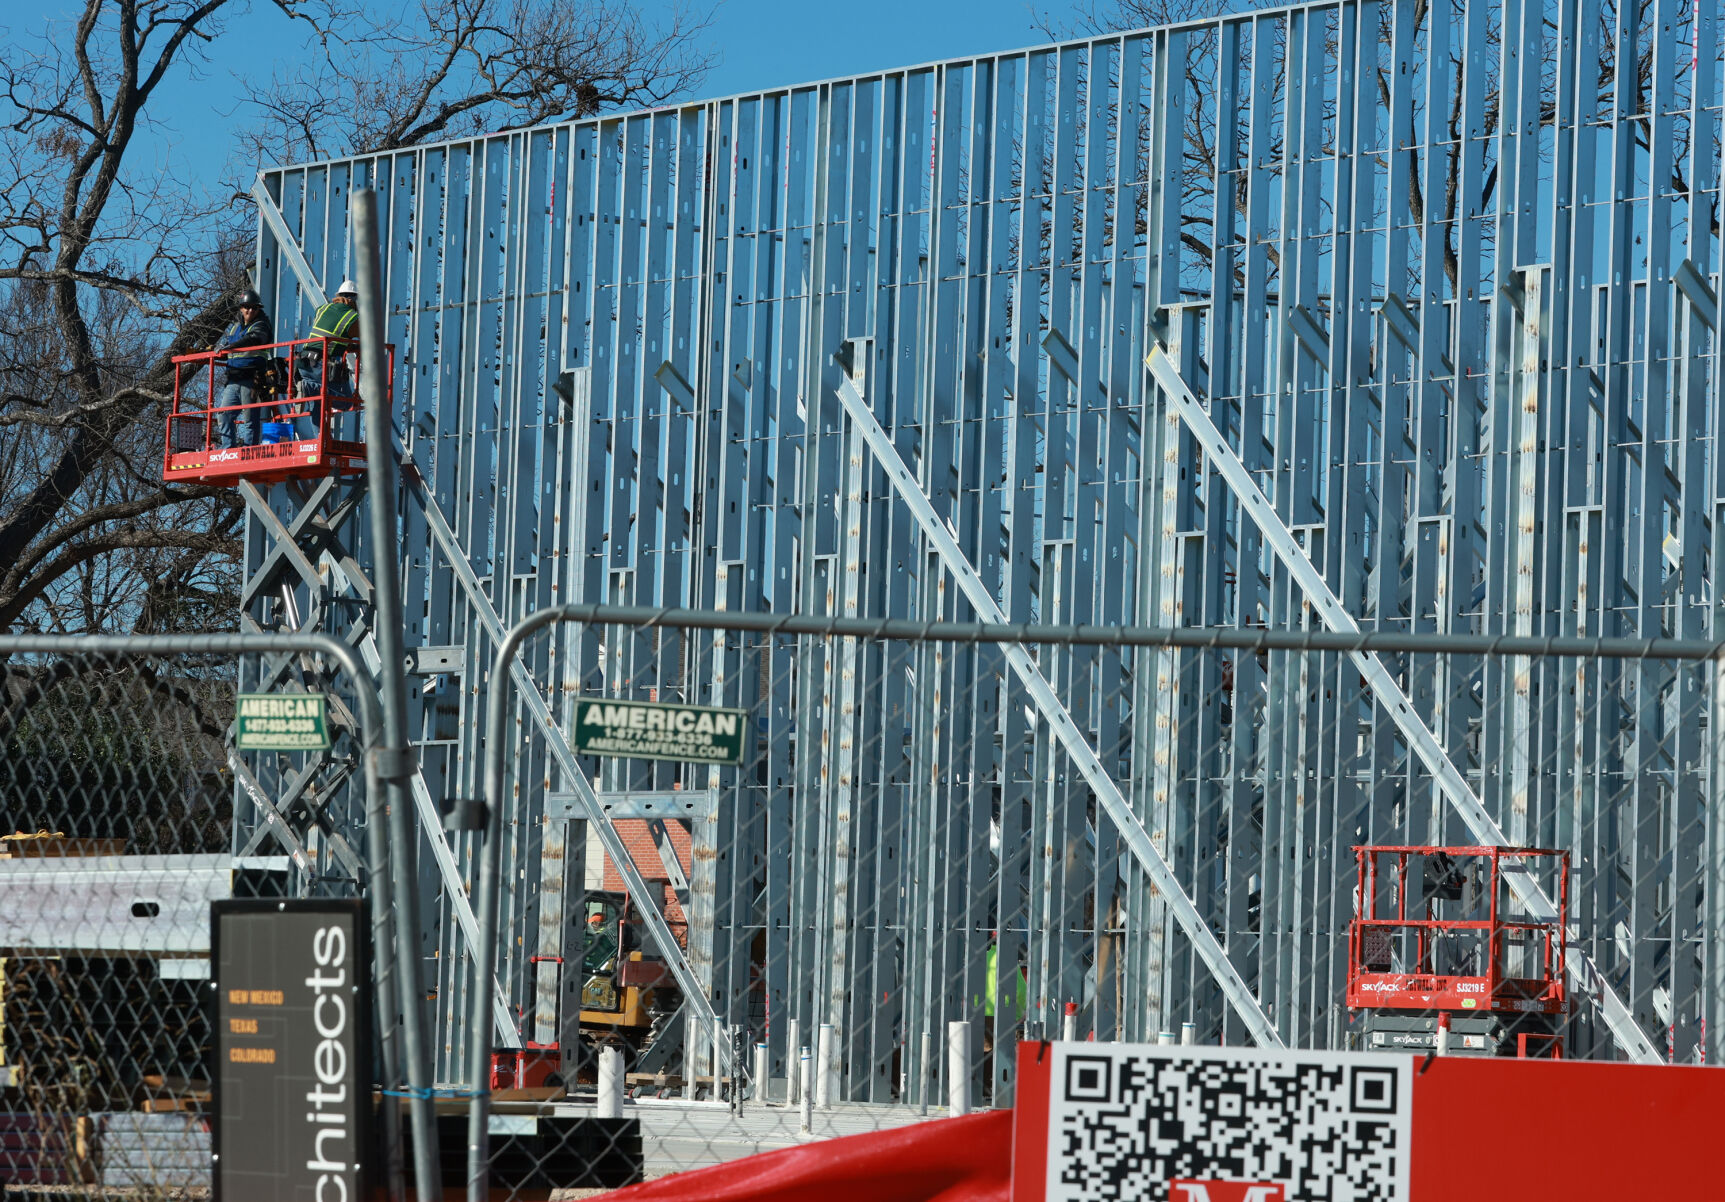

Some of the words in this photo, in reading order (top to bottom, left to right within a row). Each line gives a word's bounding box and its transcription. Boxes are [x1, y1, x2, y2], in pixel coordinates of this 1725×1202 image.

[209, 450, 239, 462] SKYJACK
[279, 443, 295, 457] INC.
[240, 699, 319, 718] AMERICAN
[583, 704, 736, 736] AMERICAN
[587, 737, 729, 759] AMERICANFENCE.COM
[1361, 980, 1400, 993] SKYJACK
[1480, 983, 1485, 993] E
[229, 989, 249, 1004] NEW
[250, 990, 285, 1005] MEXICO
[229, 1018, 259, 1035] TEXAS
[1393, 1034, 1423, 1045] SKYJACK
[229, 1047, 276, 1064] COLORADO
